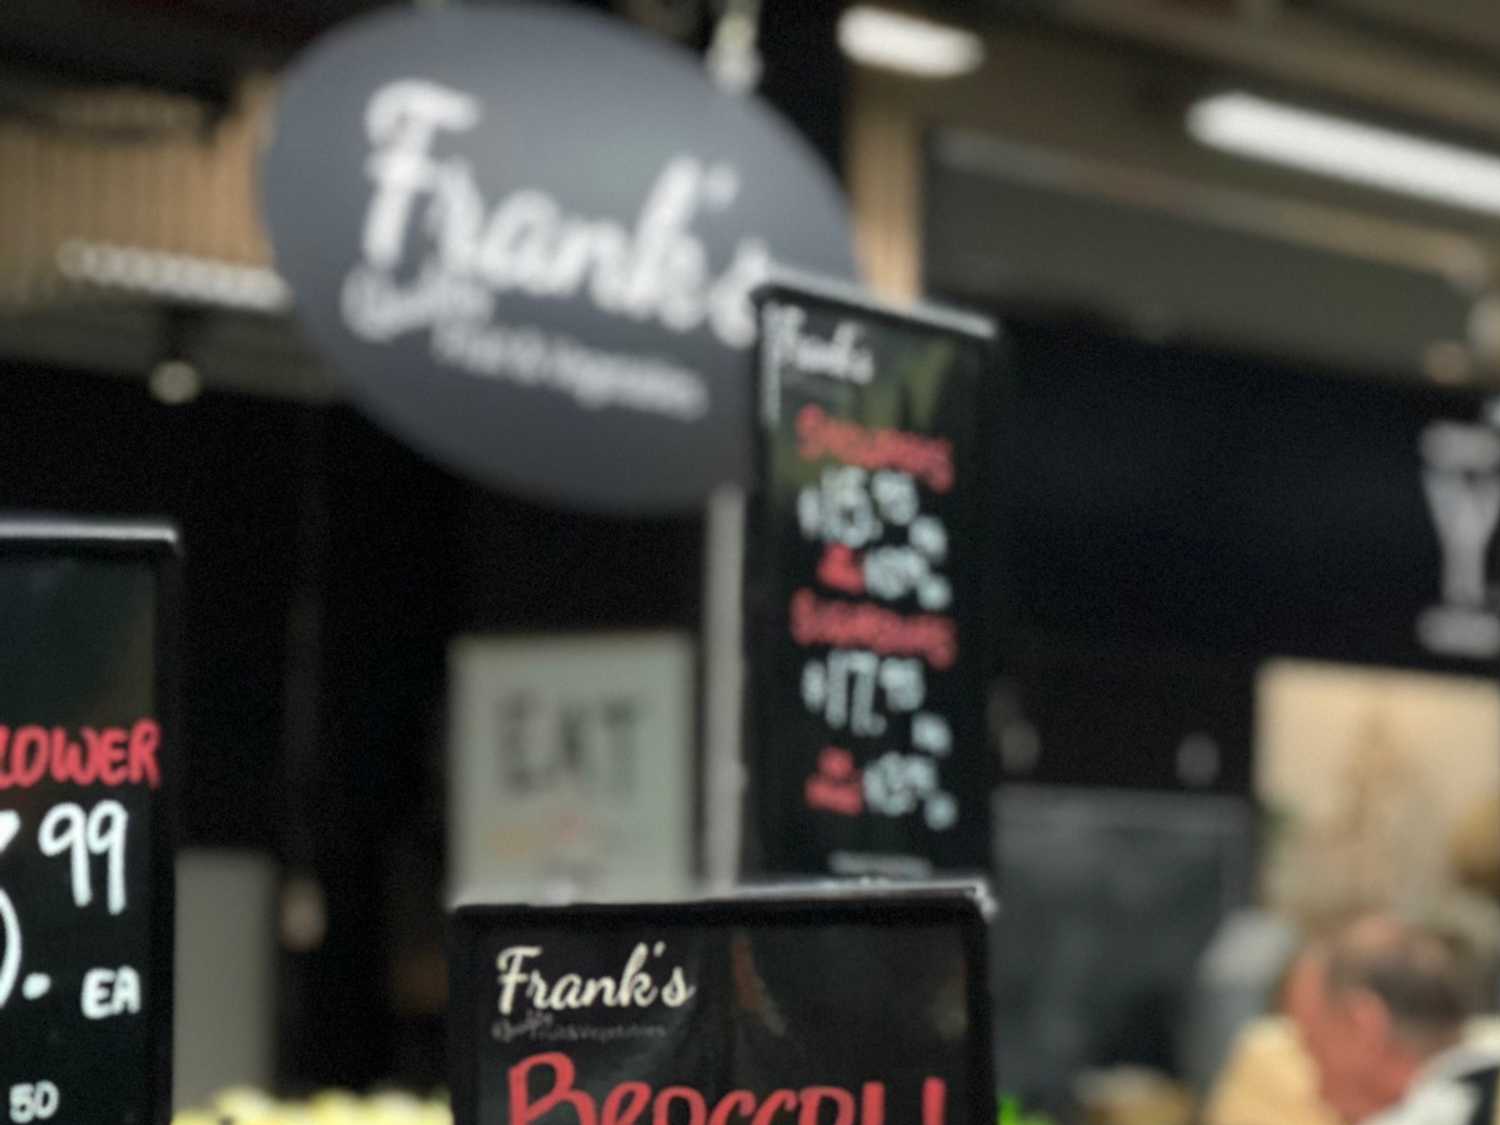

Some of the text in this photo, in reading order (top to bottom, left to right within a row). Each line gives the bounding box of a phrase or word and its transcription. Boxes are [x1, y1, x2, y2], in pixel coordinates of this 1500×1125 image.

[364, 78, 765, 350] Frank's
[81, 965, 141, 1020] EA
[496, 941, 696, 1015] Frank's
